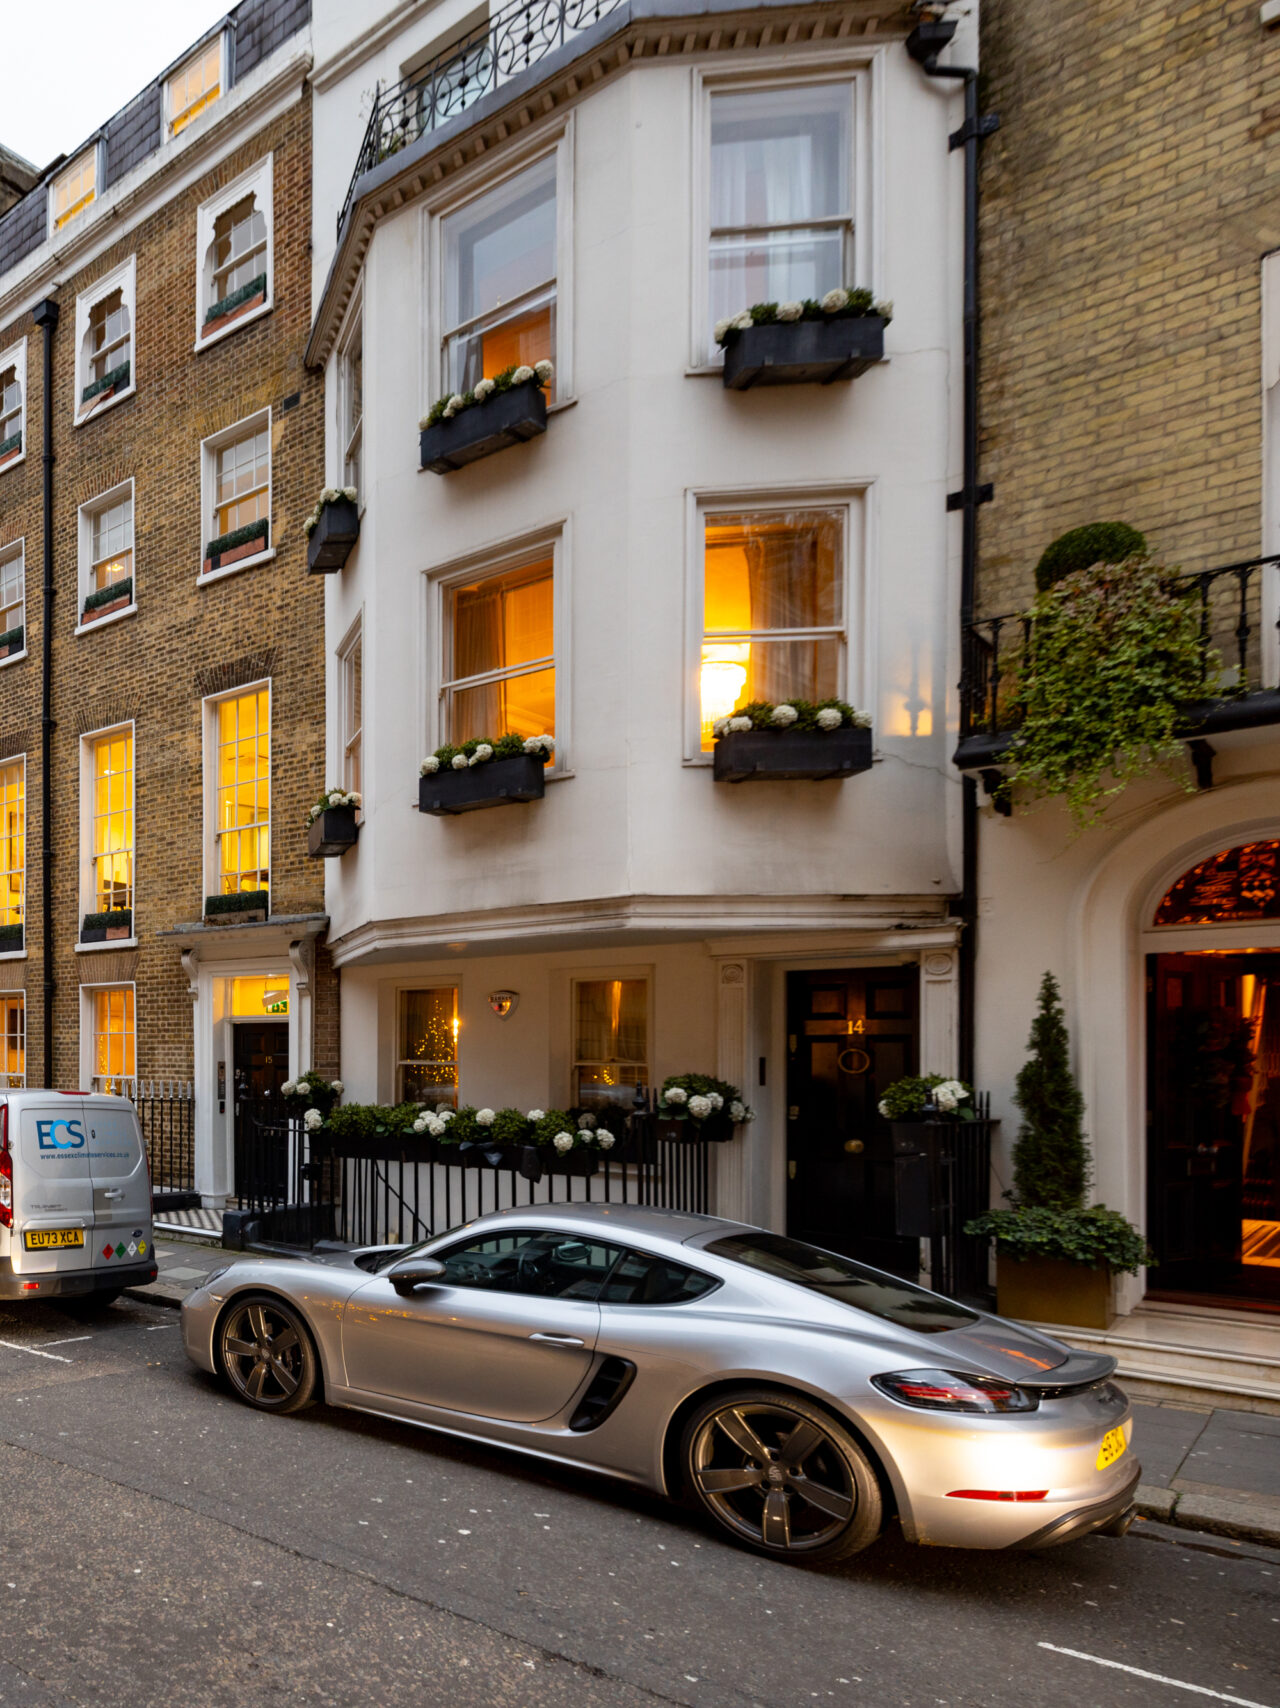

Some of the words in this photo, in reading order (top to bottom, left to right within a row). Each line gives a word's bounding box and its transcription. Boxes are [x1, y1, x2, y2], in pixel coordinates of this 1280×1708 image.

[847, 1019, 866, 1035] 14
[265, 1055, 273, 1064] 15
[36, 1119, 85, 1150] ECS
[40, 1151, 130, 1160] www.essexclimateservices.co.uk
[30, 1232, 58, 1246] EU73
[60, 1231, 80, 1244] XCA
